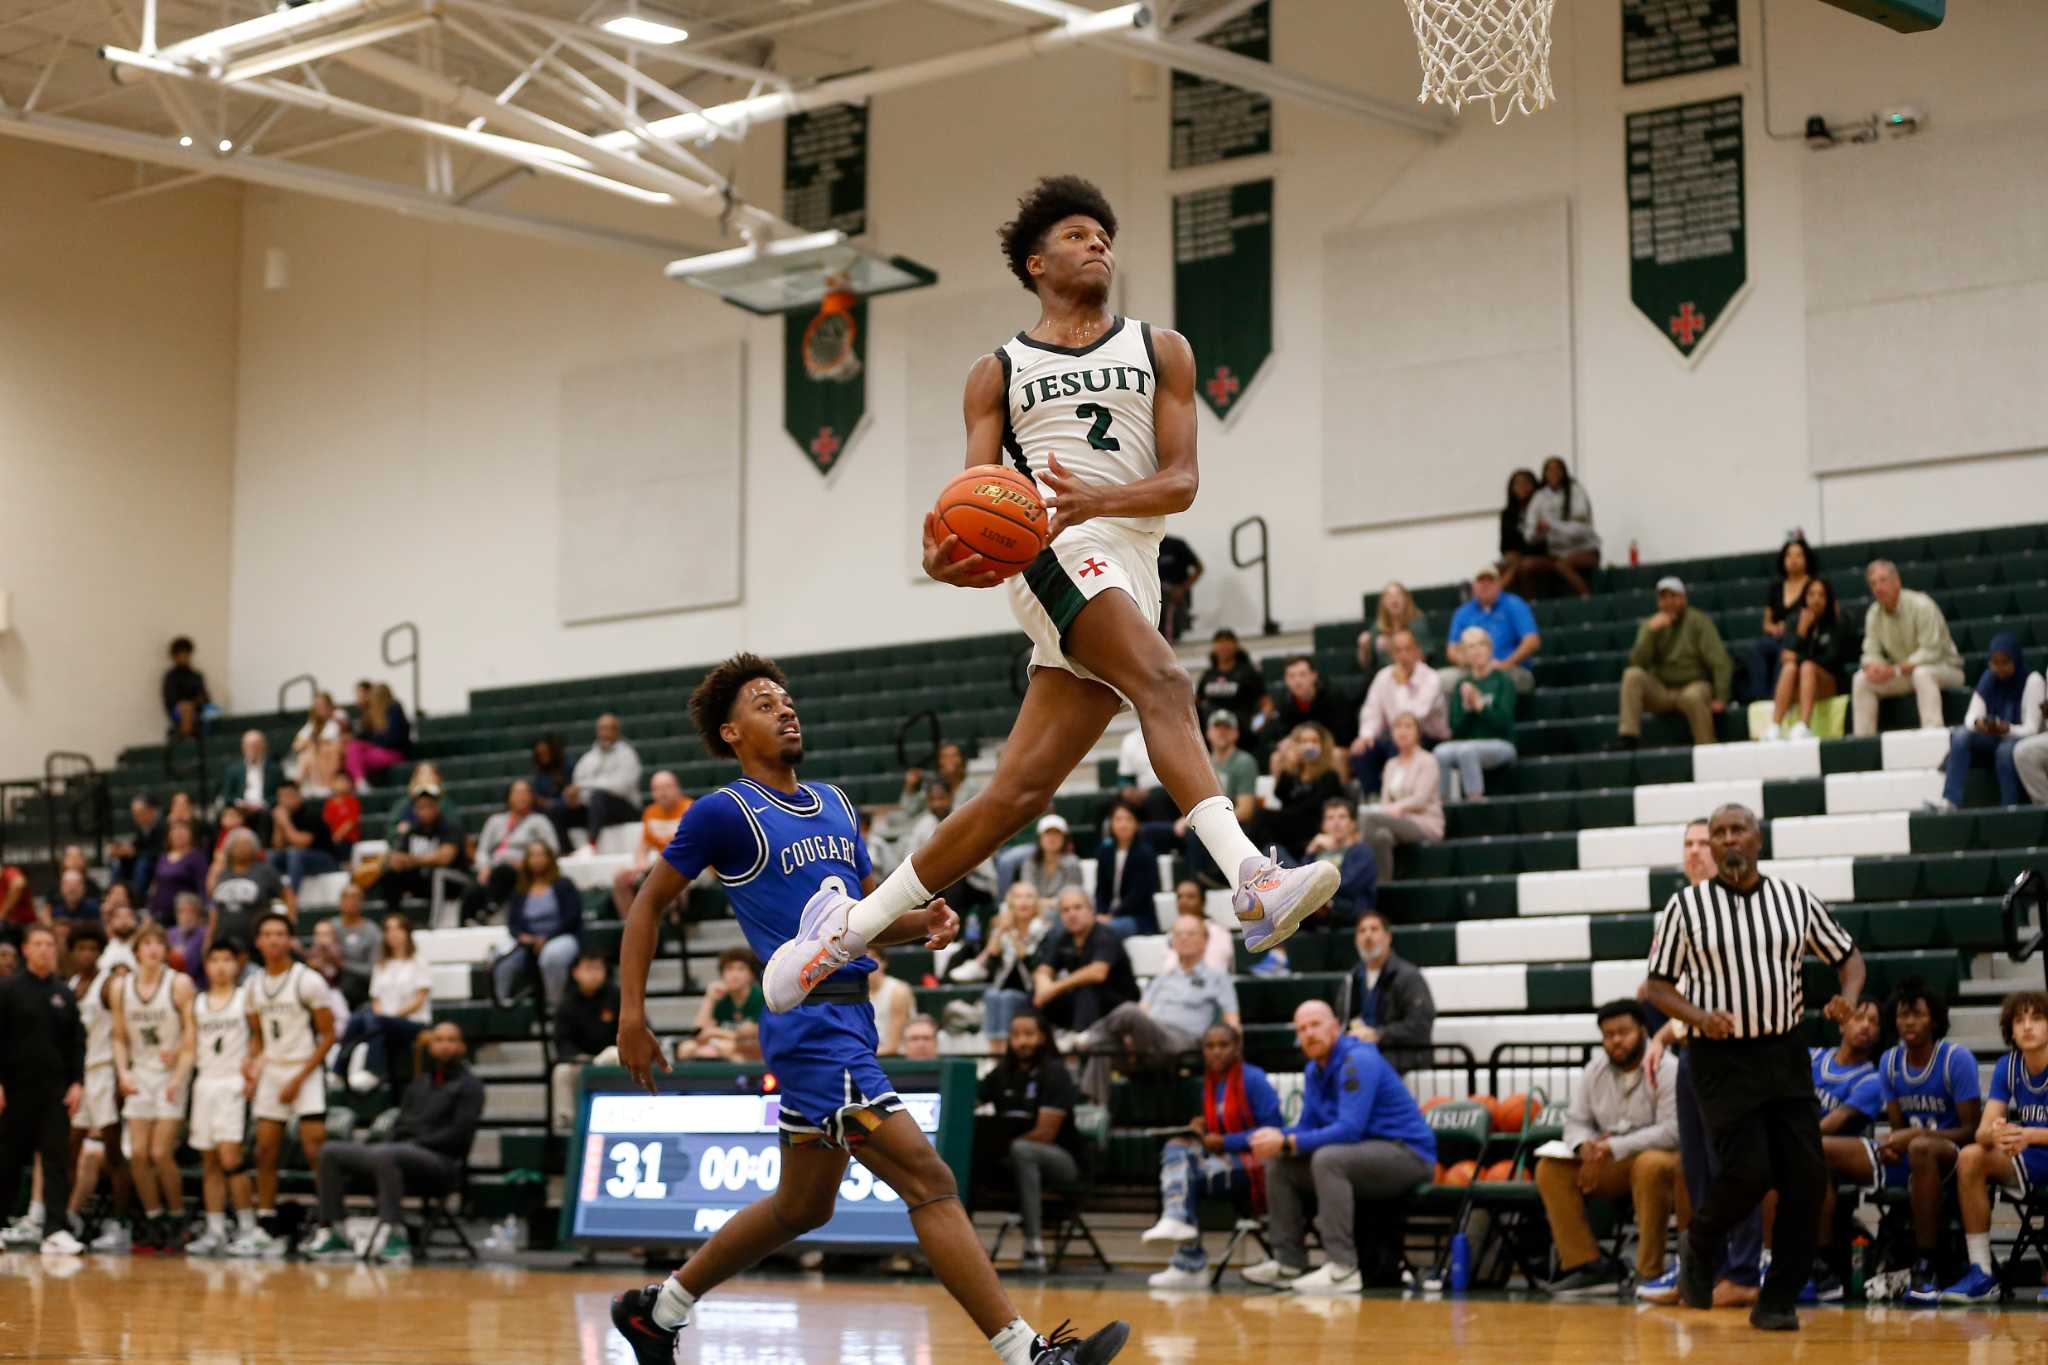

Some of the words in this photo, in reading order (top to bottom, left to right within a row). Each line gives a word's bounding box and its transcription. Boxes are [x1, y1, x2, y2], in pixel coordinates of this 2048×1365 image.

[1020, 366, 1151, 412] JESUIT
[1075, 402, 1121, 451] 2
[973, 483, 1042, 522] Baden
[980, 527, 1018, 549] JESUIT
[605, 1141, 668, 1200] 31
